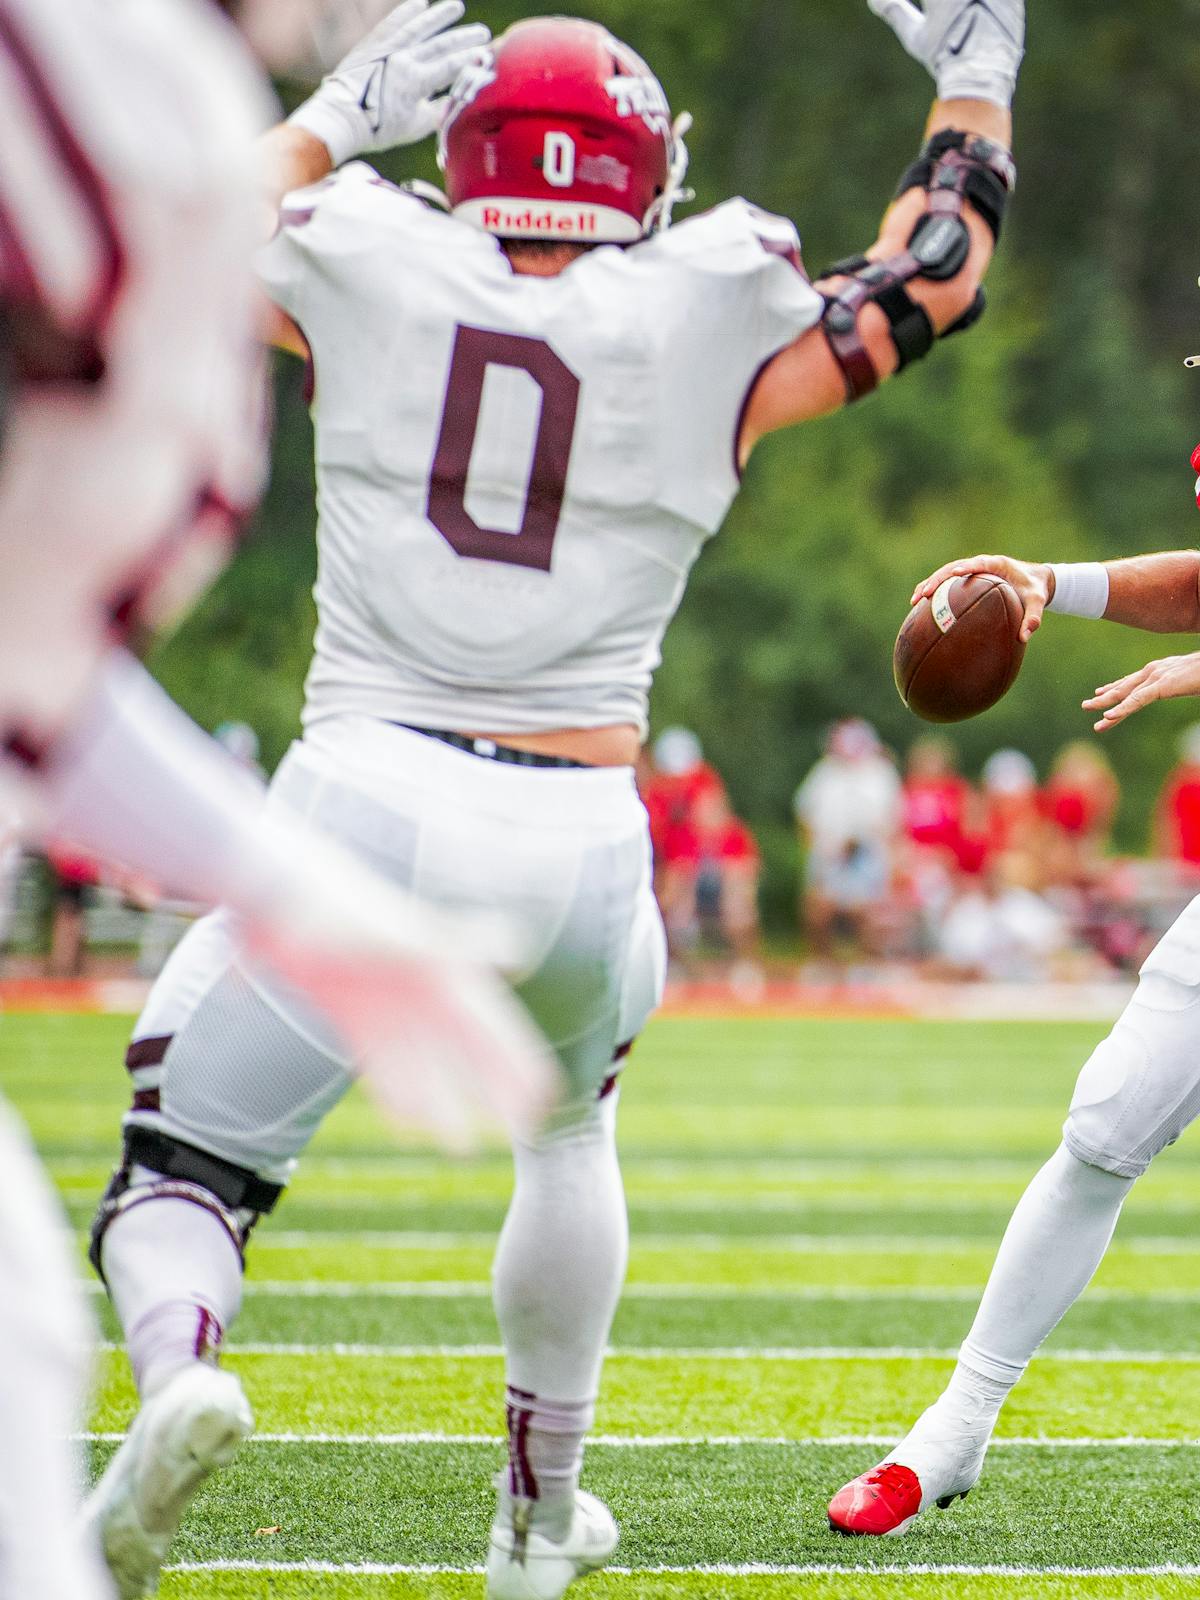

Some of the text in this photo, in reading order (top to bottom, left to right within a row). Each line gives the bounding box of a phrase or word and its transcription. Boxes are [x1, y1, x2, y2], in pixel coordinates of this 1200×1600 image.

[543, 131, 576, 188] 0
[483, 207, 596, 232] Riddell
[426, 323, 581, 574] 0
